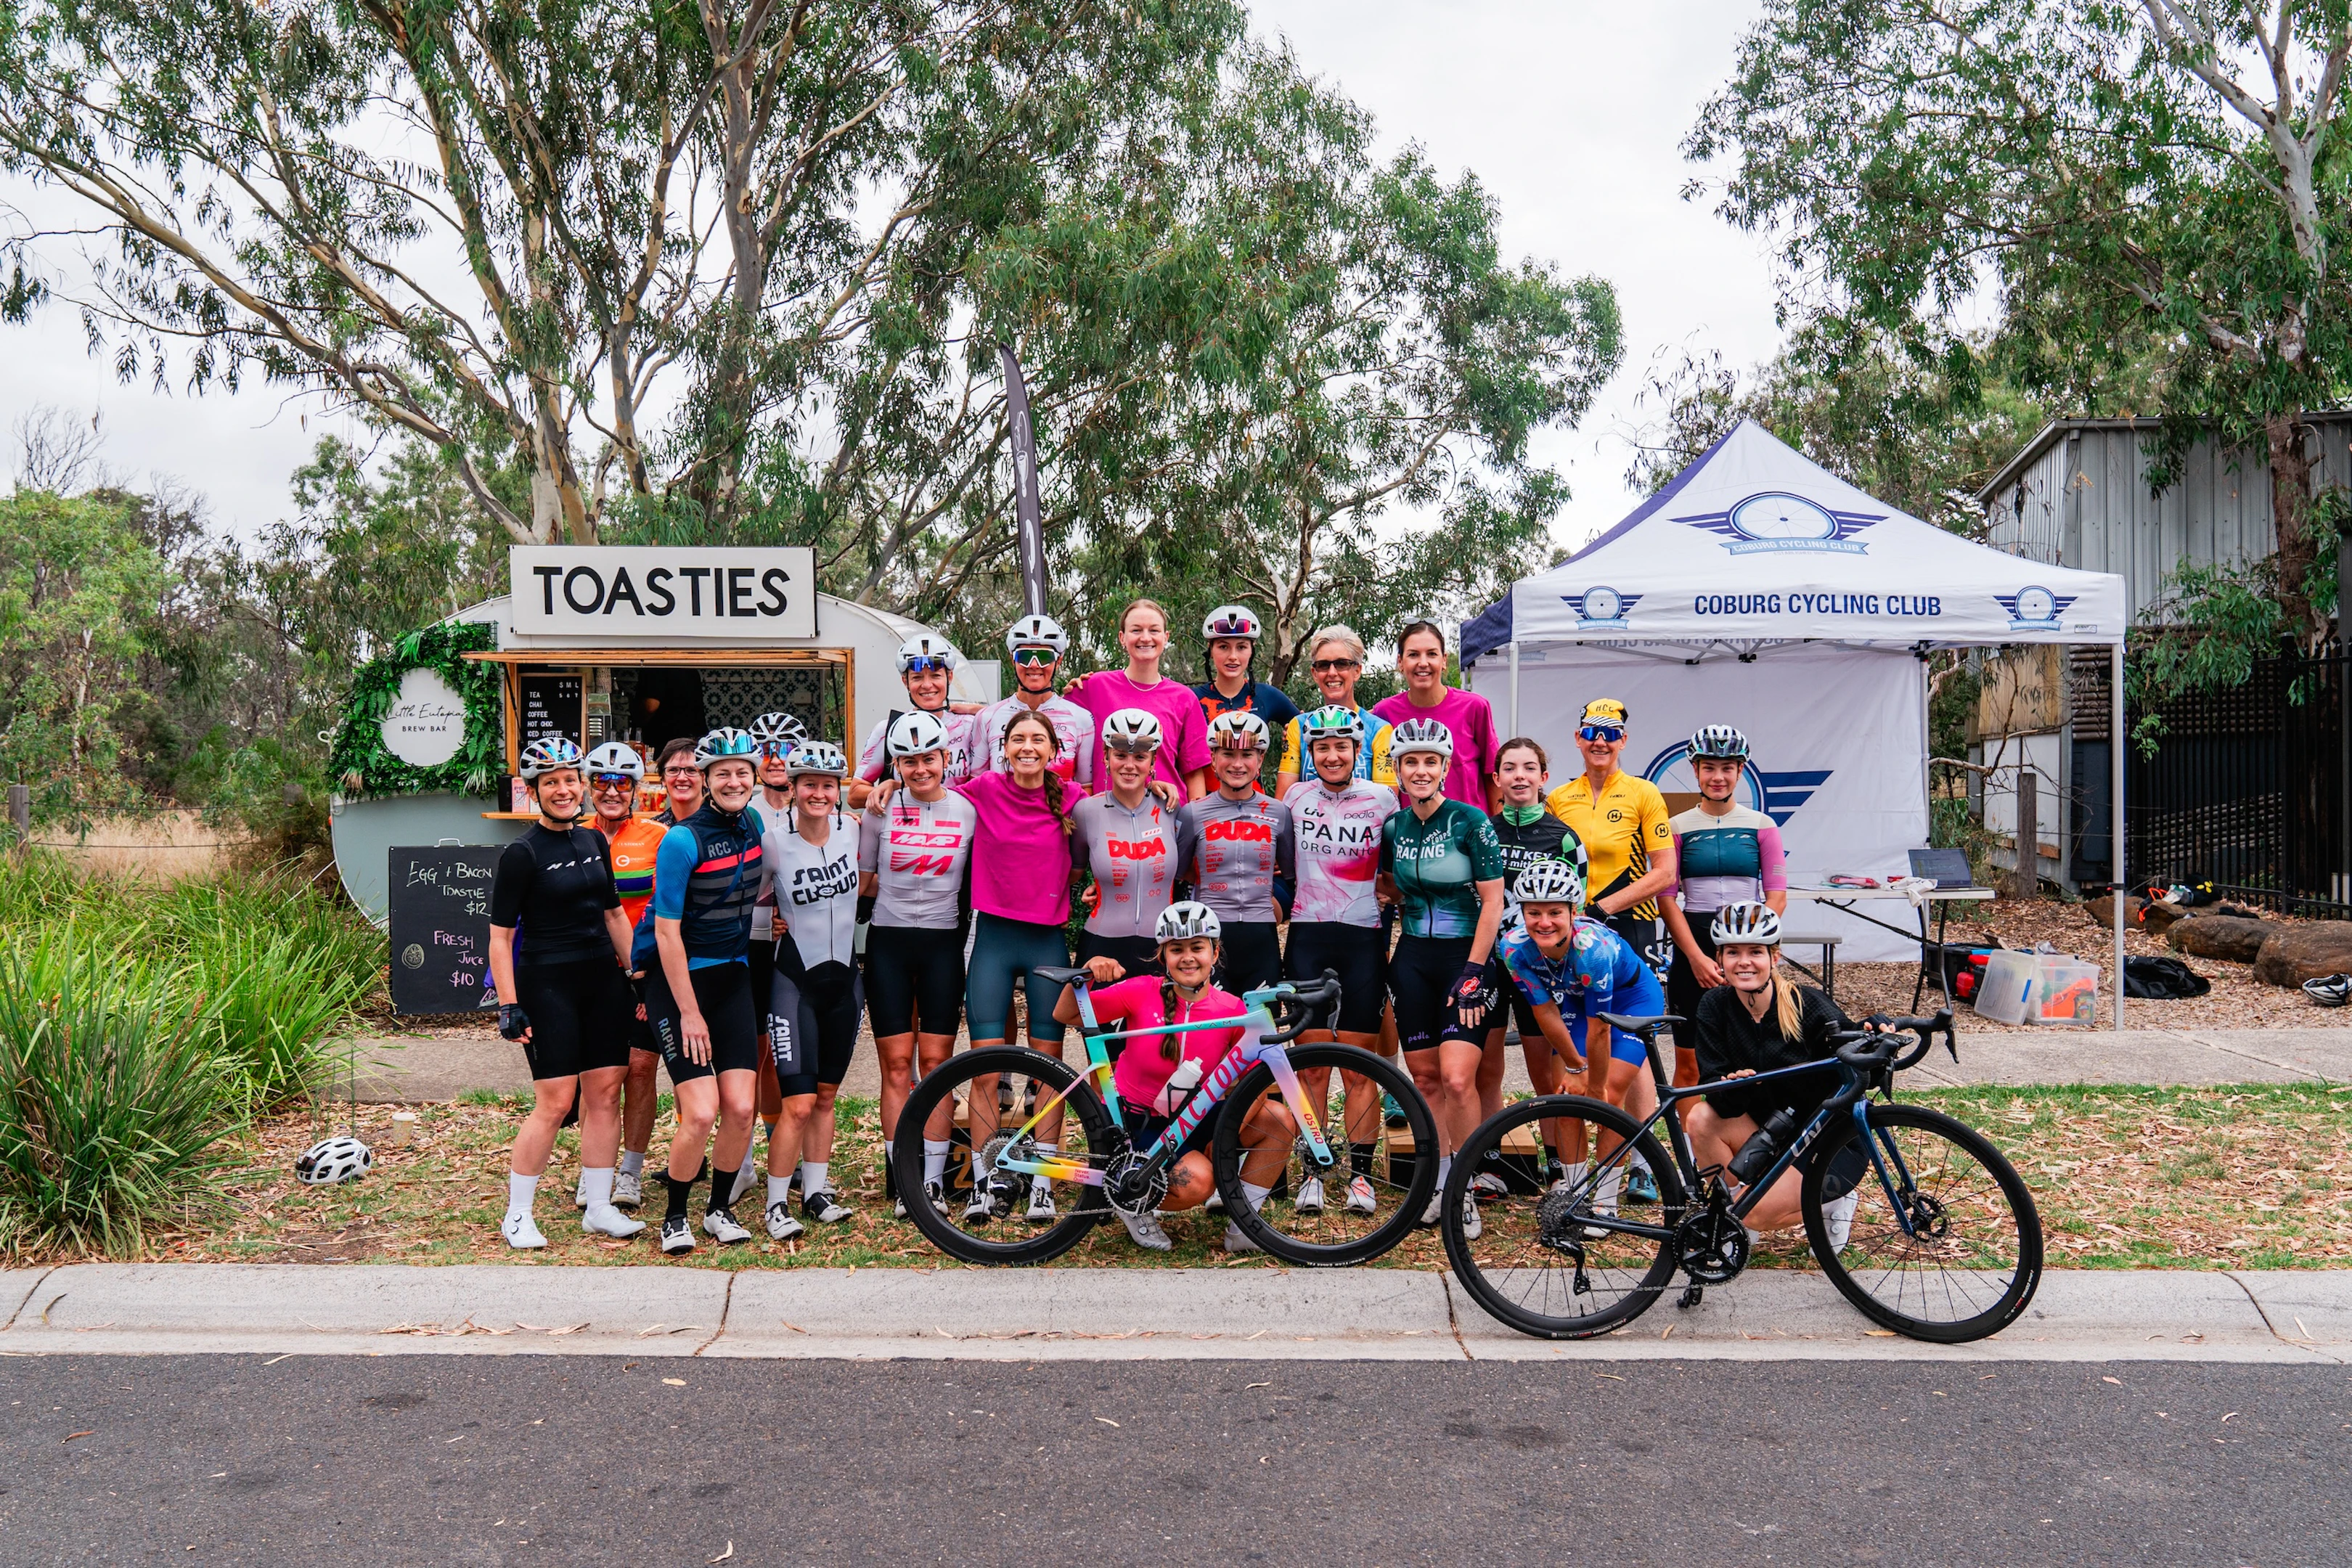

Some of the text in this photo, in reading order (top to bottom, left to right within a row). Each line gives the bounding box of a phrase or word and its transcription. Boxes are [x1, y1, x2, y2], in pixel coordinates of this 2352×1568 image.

[1732, 540, 1860, 552] COBURG CYCLING CLUB
[533, 565, 791, 617] TOASTIES
[1694, 593, 1942, 616] COBURG CYCLING CLUB
[1304, 807, 1375, 820] Liv pedla
[893, 833, 956, 846] MAAP
[1205, 820, 1273, 843] DUDA
[1302, 820, 1374, 843] PANA
[1422, 828, 1442, 844] LOCAL
[1431, 830, 1451, 845] LOOPS
[1689, 833, 1750, 843] MAAP
[707, 841, 732, 858] RCC
[1108, 837, 1166, 860] DUDA
[1301, 841, 1374, 857] ORGANIC
[1396, 844, 1445, 860] RACING
[407, 861, 437, 887] EGG
[455, 862, 493, 878] BACON
[793, 853, 849, 886] SAINT
[438, 884, 486, 899] TOASTIE
[464, 900, 491, 916] $12
[433, 930, 474, 949] FRESH
[449, 970, 475, 987] $10
[658, 1017, 678, 1063] RAPHA
[775, 1016, 793, 1062] SAINT
[1408, 1031, 1430, 1043] pedla
[1442, 1024, 1458, 1037] pedla
[1160, 1045, 1251, 1145] FACTOR
[1304, 1113, 1324, 1144] OSTRO
[1790, 1120, 1822, 1157] Liv
[953, 1143, 974, 1188] 2
[1220, 1146, 1264, 1234] BLACK
